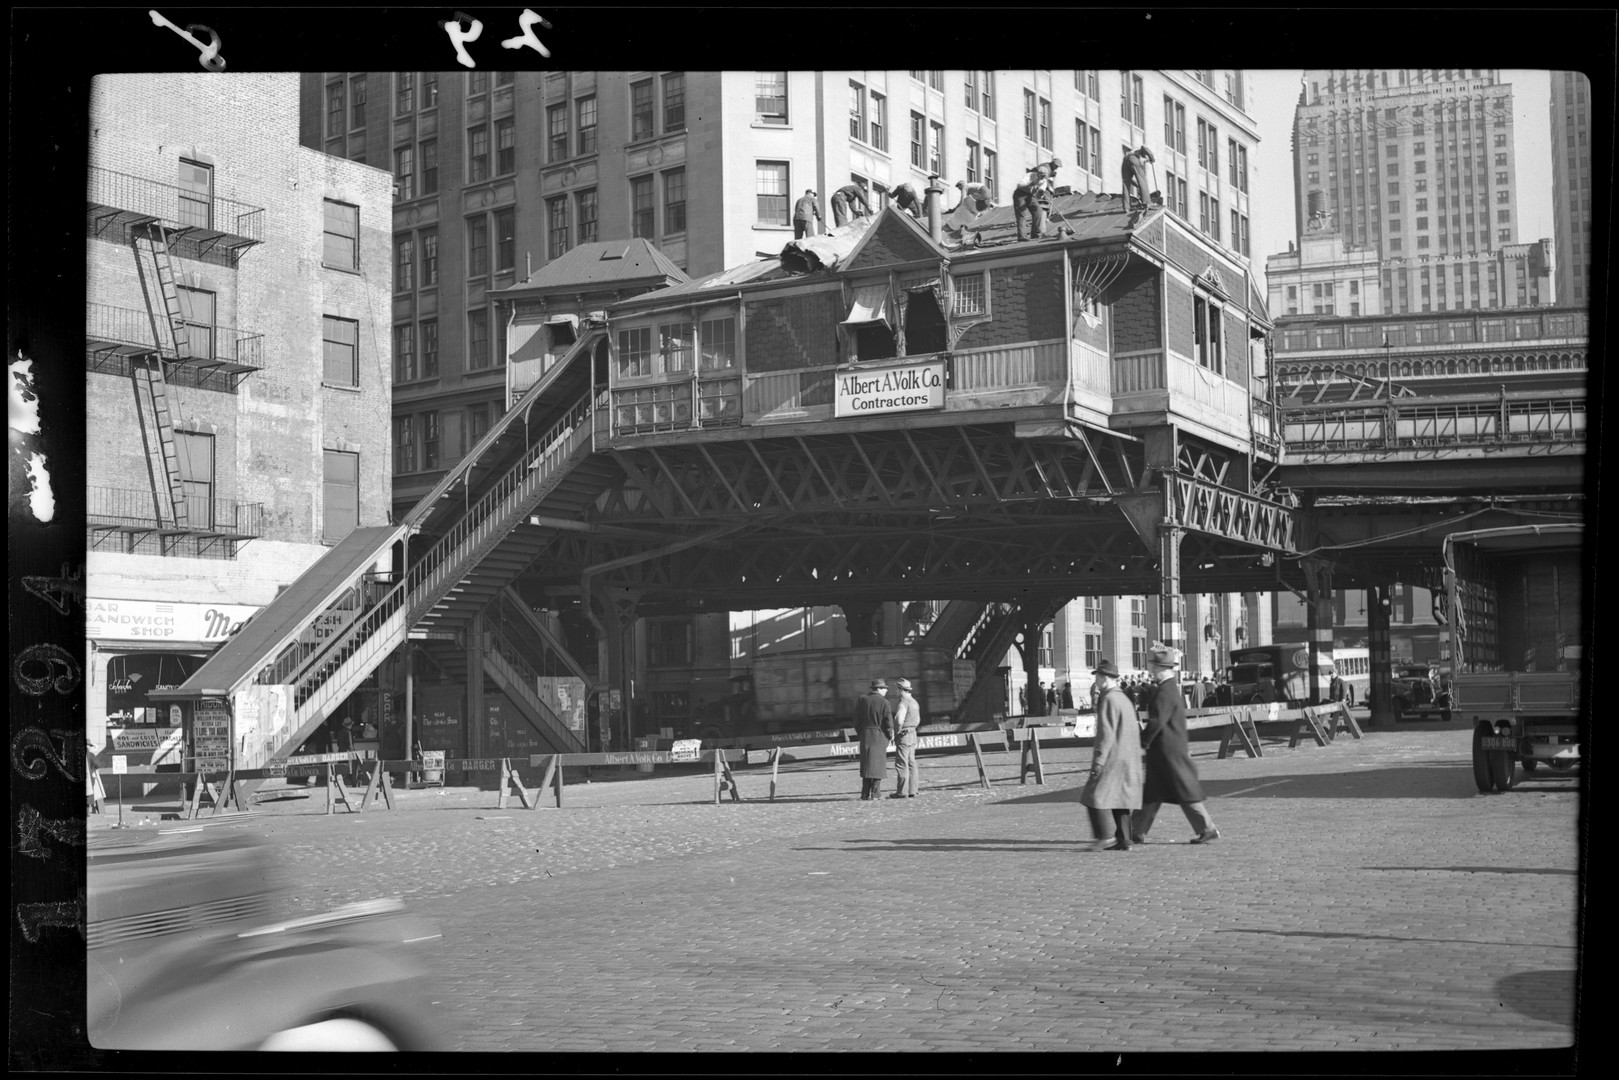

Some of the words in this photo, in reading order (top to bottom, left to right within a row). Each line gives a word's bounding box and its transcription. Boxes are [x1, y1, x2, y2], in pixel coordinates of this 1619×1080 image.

[840, 375, 880, 396] Albert
[922, 368, 942, 388] Co.
[852, 395, 929, 411] Contractors
[86, 614, 175, 626] SANDWICH
[131, 627, 174, 637] SHOP
[830, 744, 859, 755] Albert
[918, 735, 959, 749] ANGER
[322, 752, 349, 762] DANGER
[606, 754, 628, 764] Albert
[462, 759, 496, 771] DANGER
